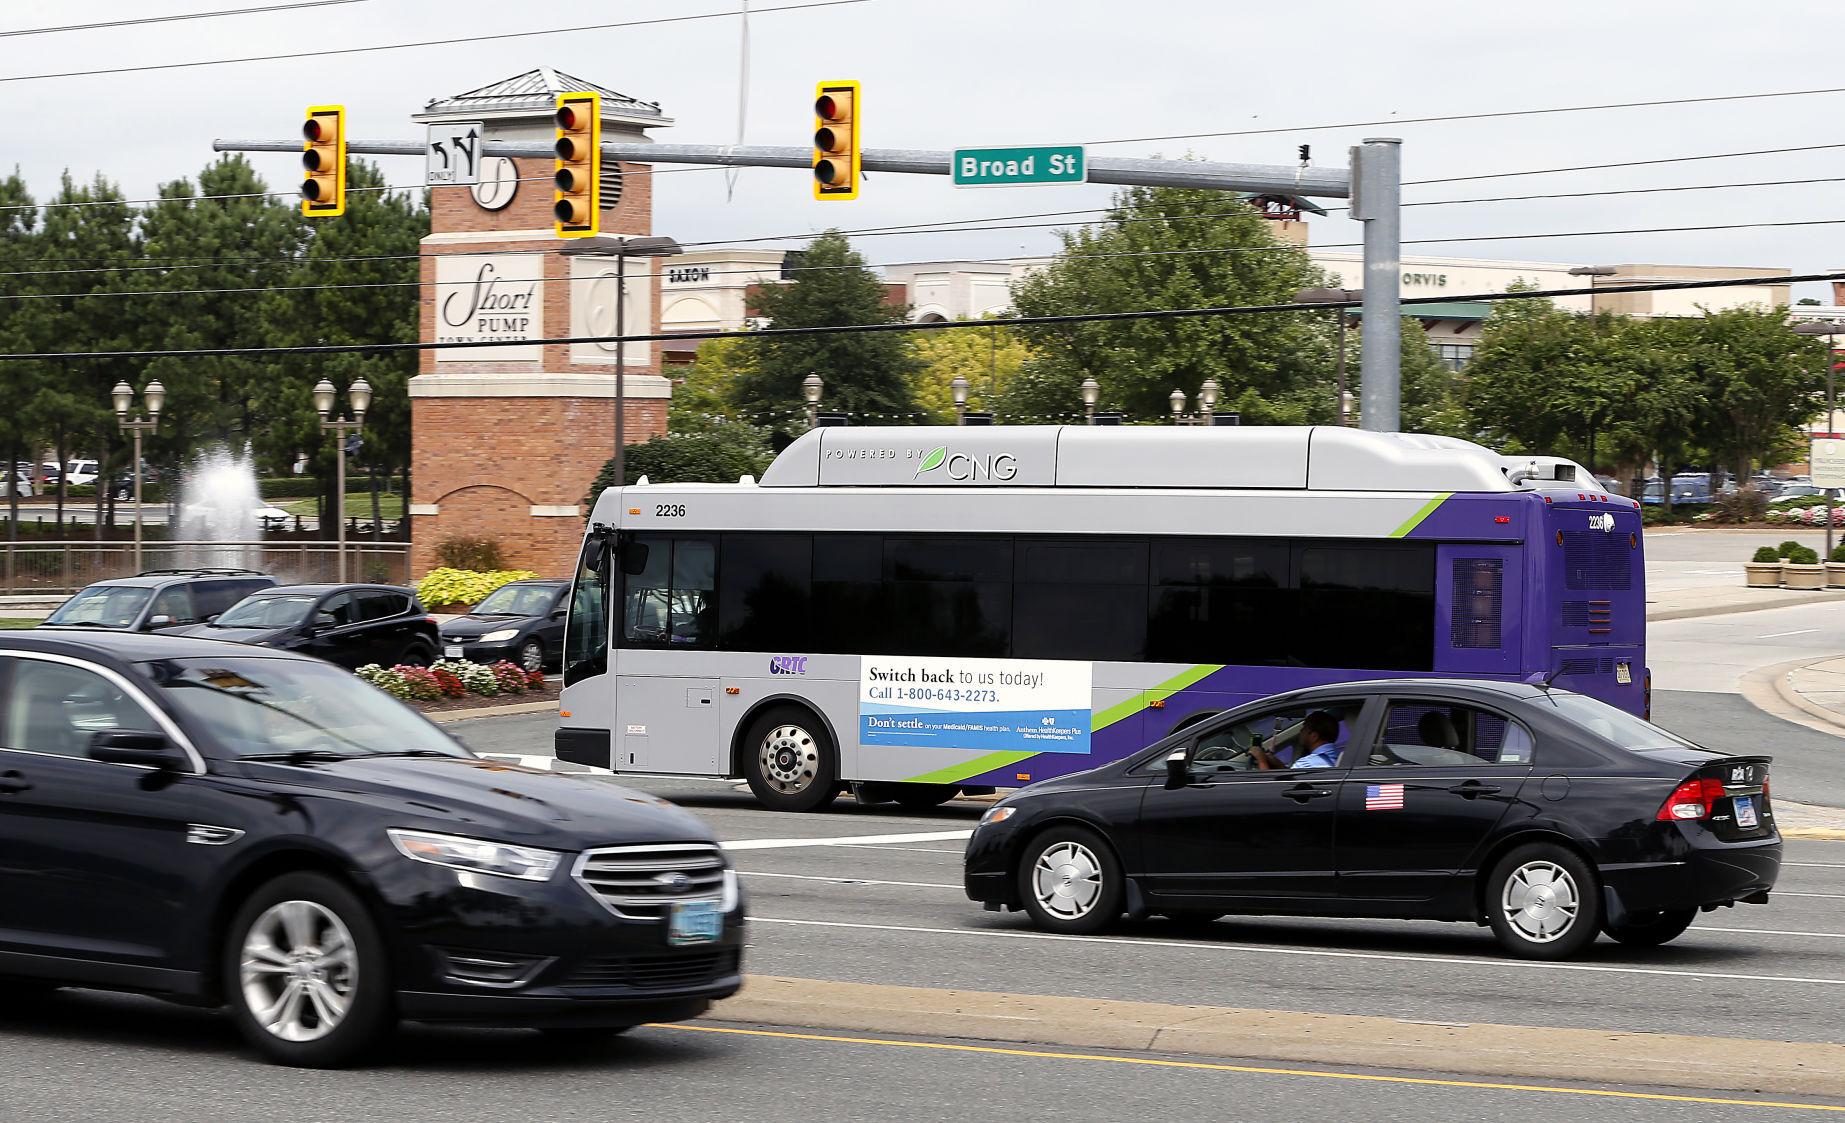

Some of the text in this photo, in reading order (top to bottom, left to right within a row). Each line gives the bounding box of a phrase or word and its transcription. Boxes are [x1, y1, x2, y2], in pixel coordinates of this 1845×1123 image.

[961, 154, 1076, 177] Broad St
[1403, 272, 1446, 287] ORVIS
[443, 263, 536, 327] Short
[478, 318, 529, 333] PUMP
[826, 449, 1018, 481] POWERED BY CNG
[656, 504, 686, 517] 2236
[1589, 515, 1604, 530] 2236
[770, 656, 808, 675] GRTC
[869, 667, 1044, 689] Switch back to us today!
[869, 687, 1000, 702] Call 1-800-643-2273.
[868, 717, 896, 728] Don't
[898, 718, 923, 729] settle
